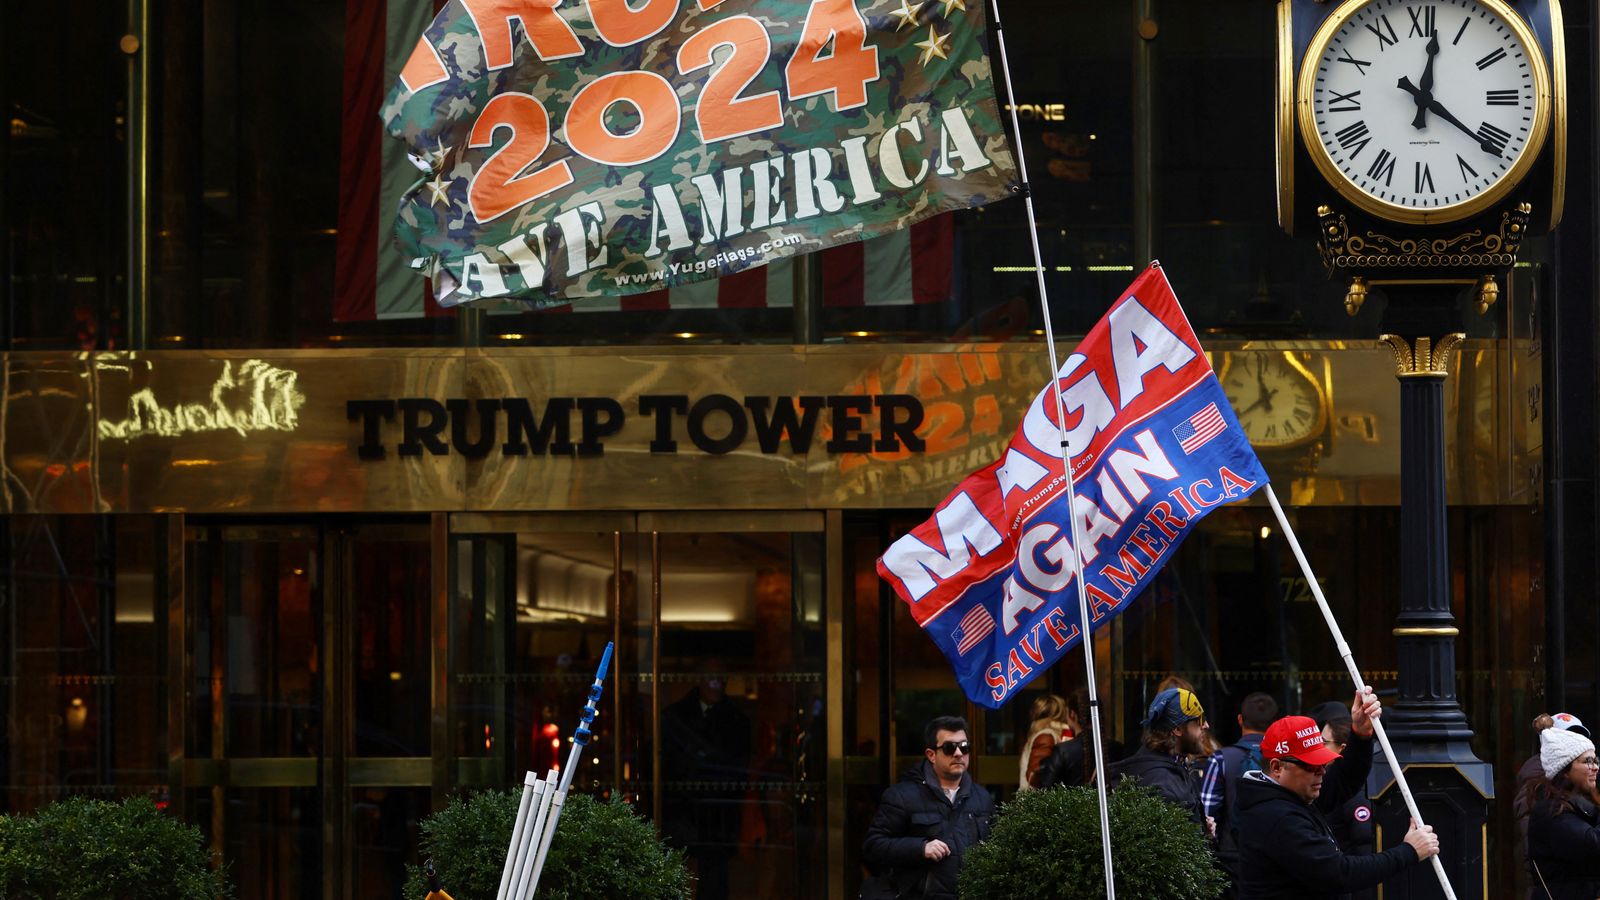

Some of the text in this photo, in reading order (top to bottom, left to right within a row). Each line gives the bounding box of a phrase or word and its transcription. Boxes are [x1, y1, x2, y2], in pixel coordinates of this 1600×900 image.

[1407, 5, 1437, 39] XII
[1337, 48, 1372, 76] X
[467, 0, 880, 223] 2024
[1328, 90, 1361, 112] IX
[1414, 161, 1436, 194] VI
[1456, 153, 1479, 184] V
[455, 107, 991, 298] AVE AMERICA
[614, 233, 801, 287] www.YugeFlags.com
[346, 397, 625, 458] TRUMP
[638, 393, 926, 456] TOWER
[882, 295, 1198, 602] MAGA
[1011, 453, 1094, 530] www.TrumpSwg.com
[1001, 428, 1179, 635] AGAIN
[983, 465, 1256, 702] SAVE AMERICA
[1275, 741, 1290, 754] 45
